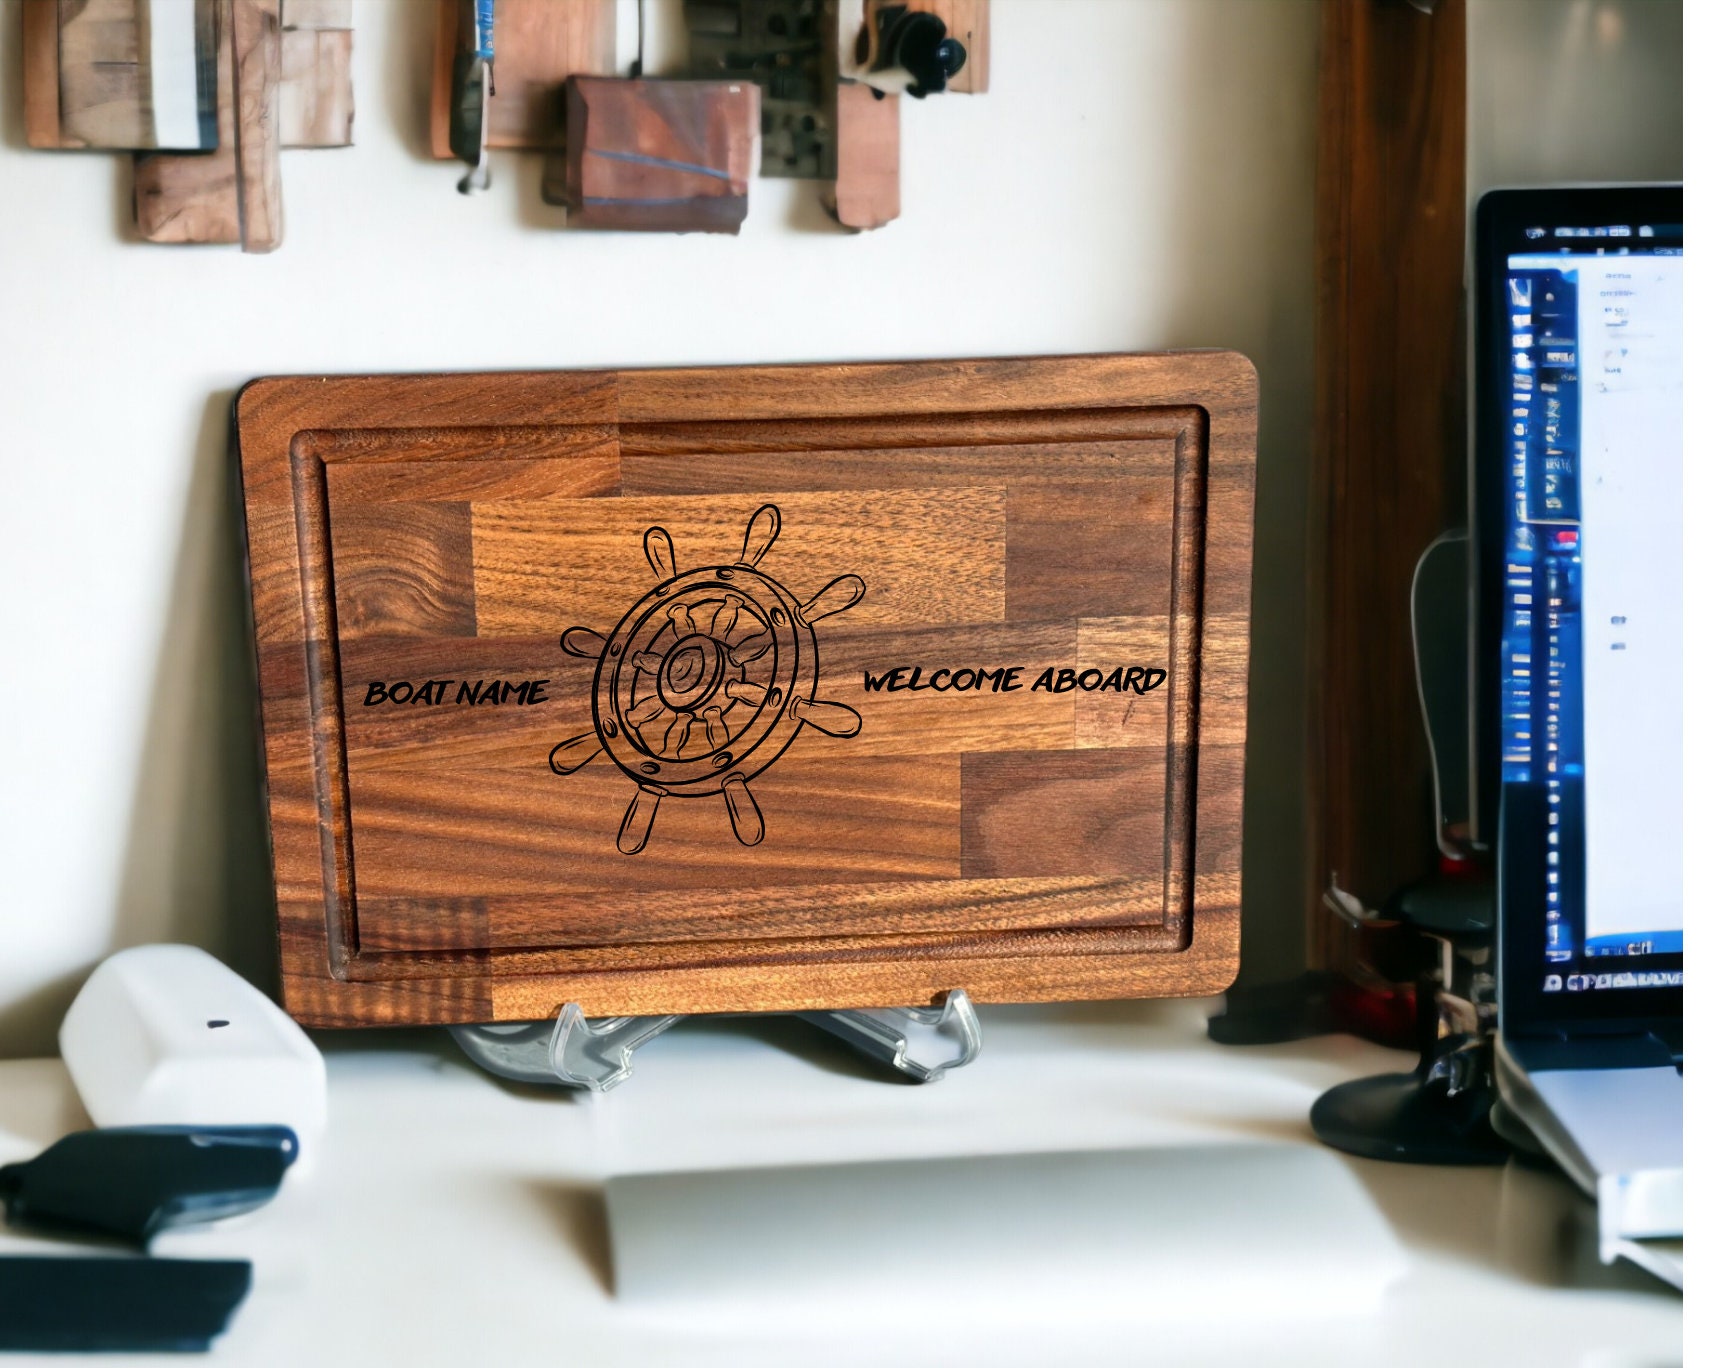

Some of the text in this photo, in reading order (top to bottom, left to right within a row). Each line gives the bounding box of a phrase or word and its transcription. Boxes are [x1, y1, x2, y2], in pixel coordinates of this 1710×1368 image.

[364, 680, 551, 706] BOAT NAME
[864, 666, 1167, 695] WELCOME ABOARD
